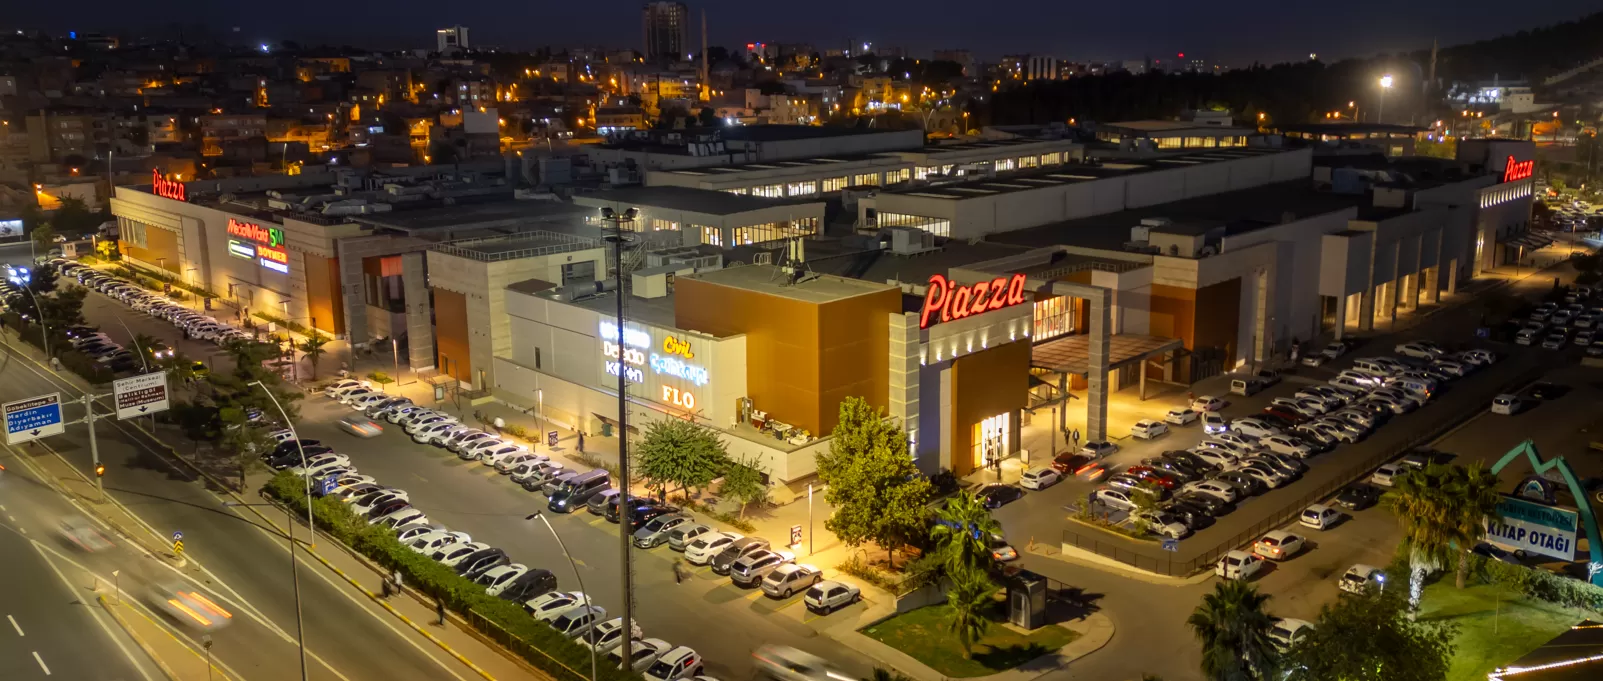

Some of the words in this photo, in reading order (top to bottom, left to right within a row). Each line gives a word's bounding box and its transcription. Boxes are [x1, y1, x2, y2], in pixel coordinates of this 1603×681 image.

[153, 168, 185, 201] Piazza
[257, 245, 287, 263] BOYNER
[920, 273, 1026, 329] Piazza
[662, 385, 695, 409] FLO
[7, 410, 37, 420] Mardin
[1529, 531, 1570, 552] OTAĞI
